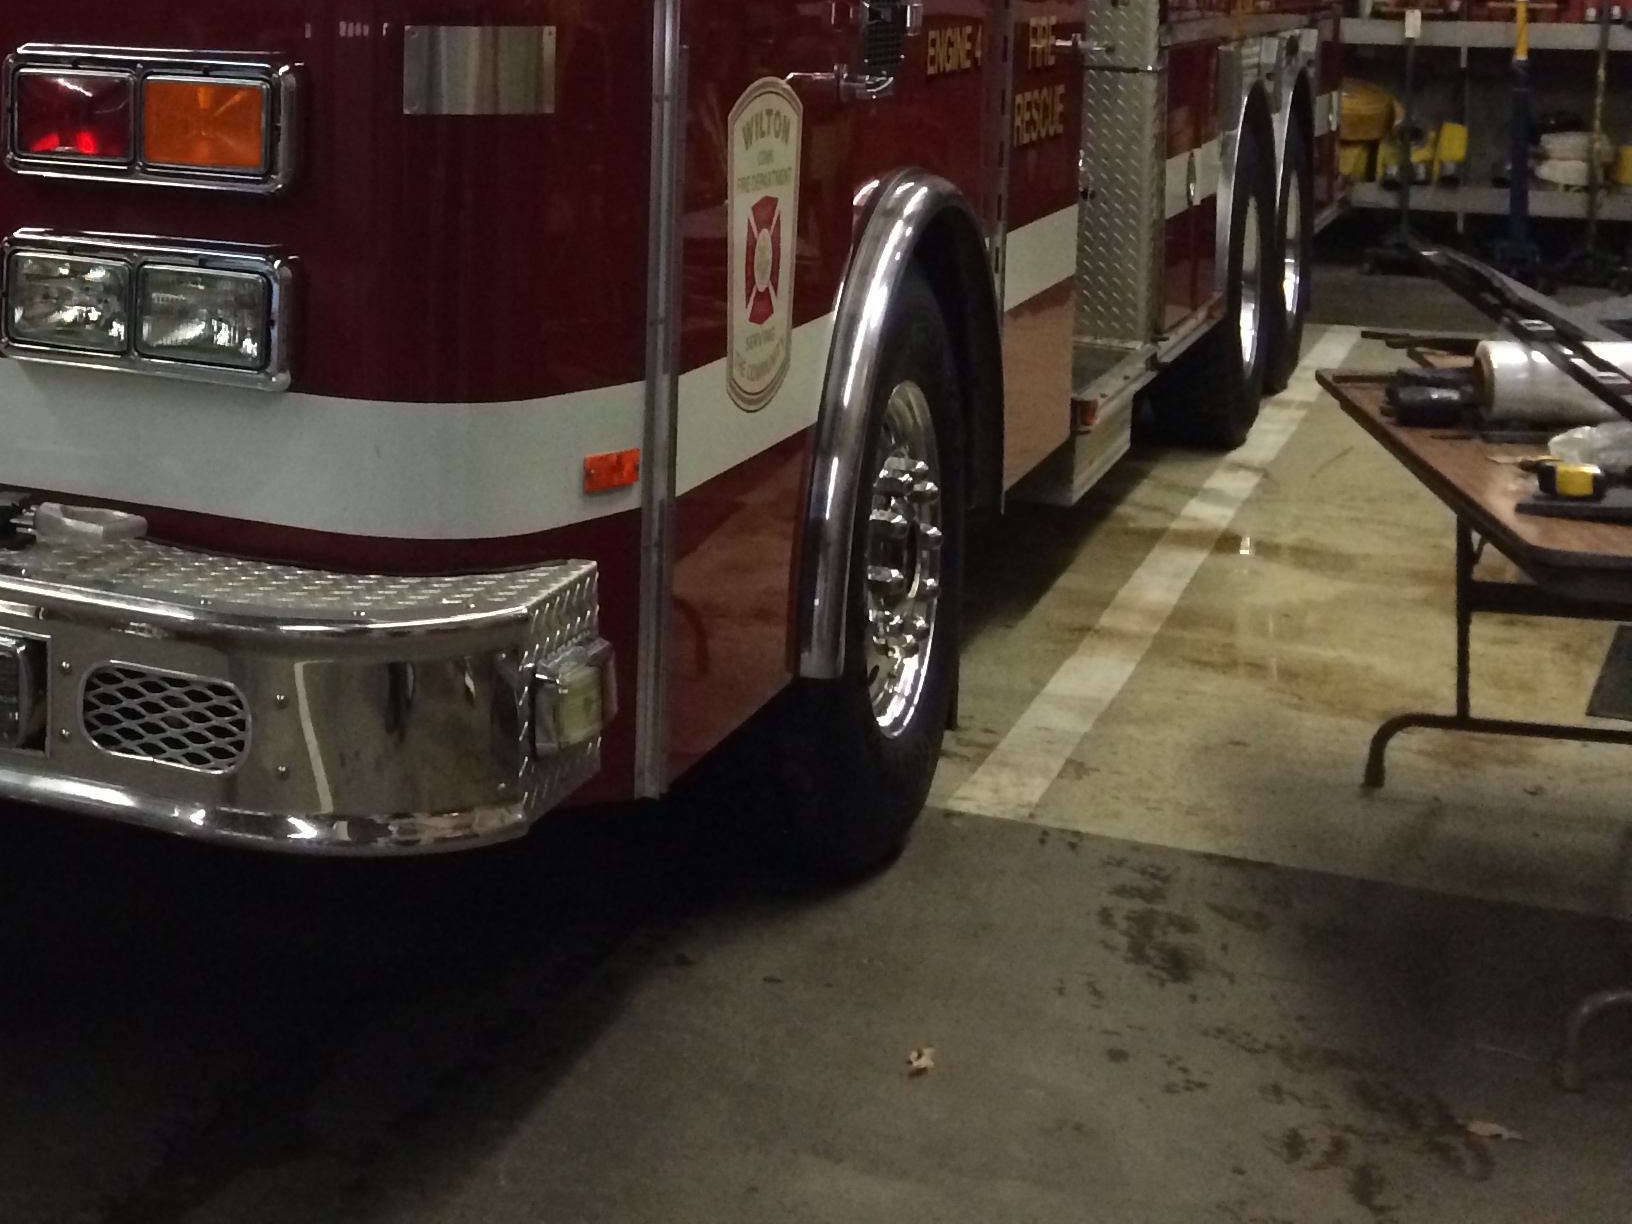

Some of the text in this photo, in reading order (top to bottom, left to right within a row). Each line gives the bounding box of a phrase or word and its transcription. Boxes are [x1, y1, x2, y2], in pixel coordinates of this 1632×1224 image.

[926, 24, 983, 76] ENGINE 4
[741, 108, 791, 152] WILTON
[1013, 84, 1066, 149] RESCUE
